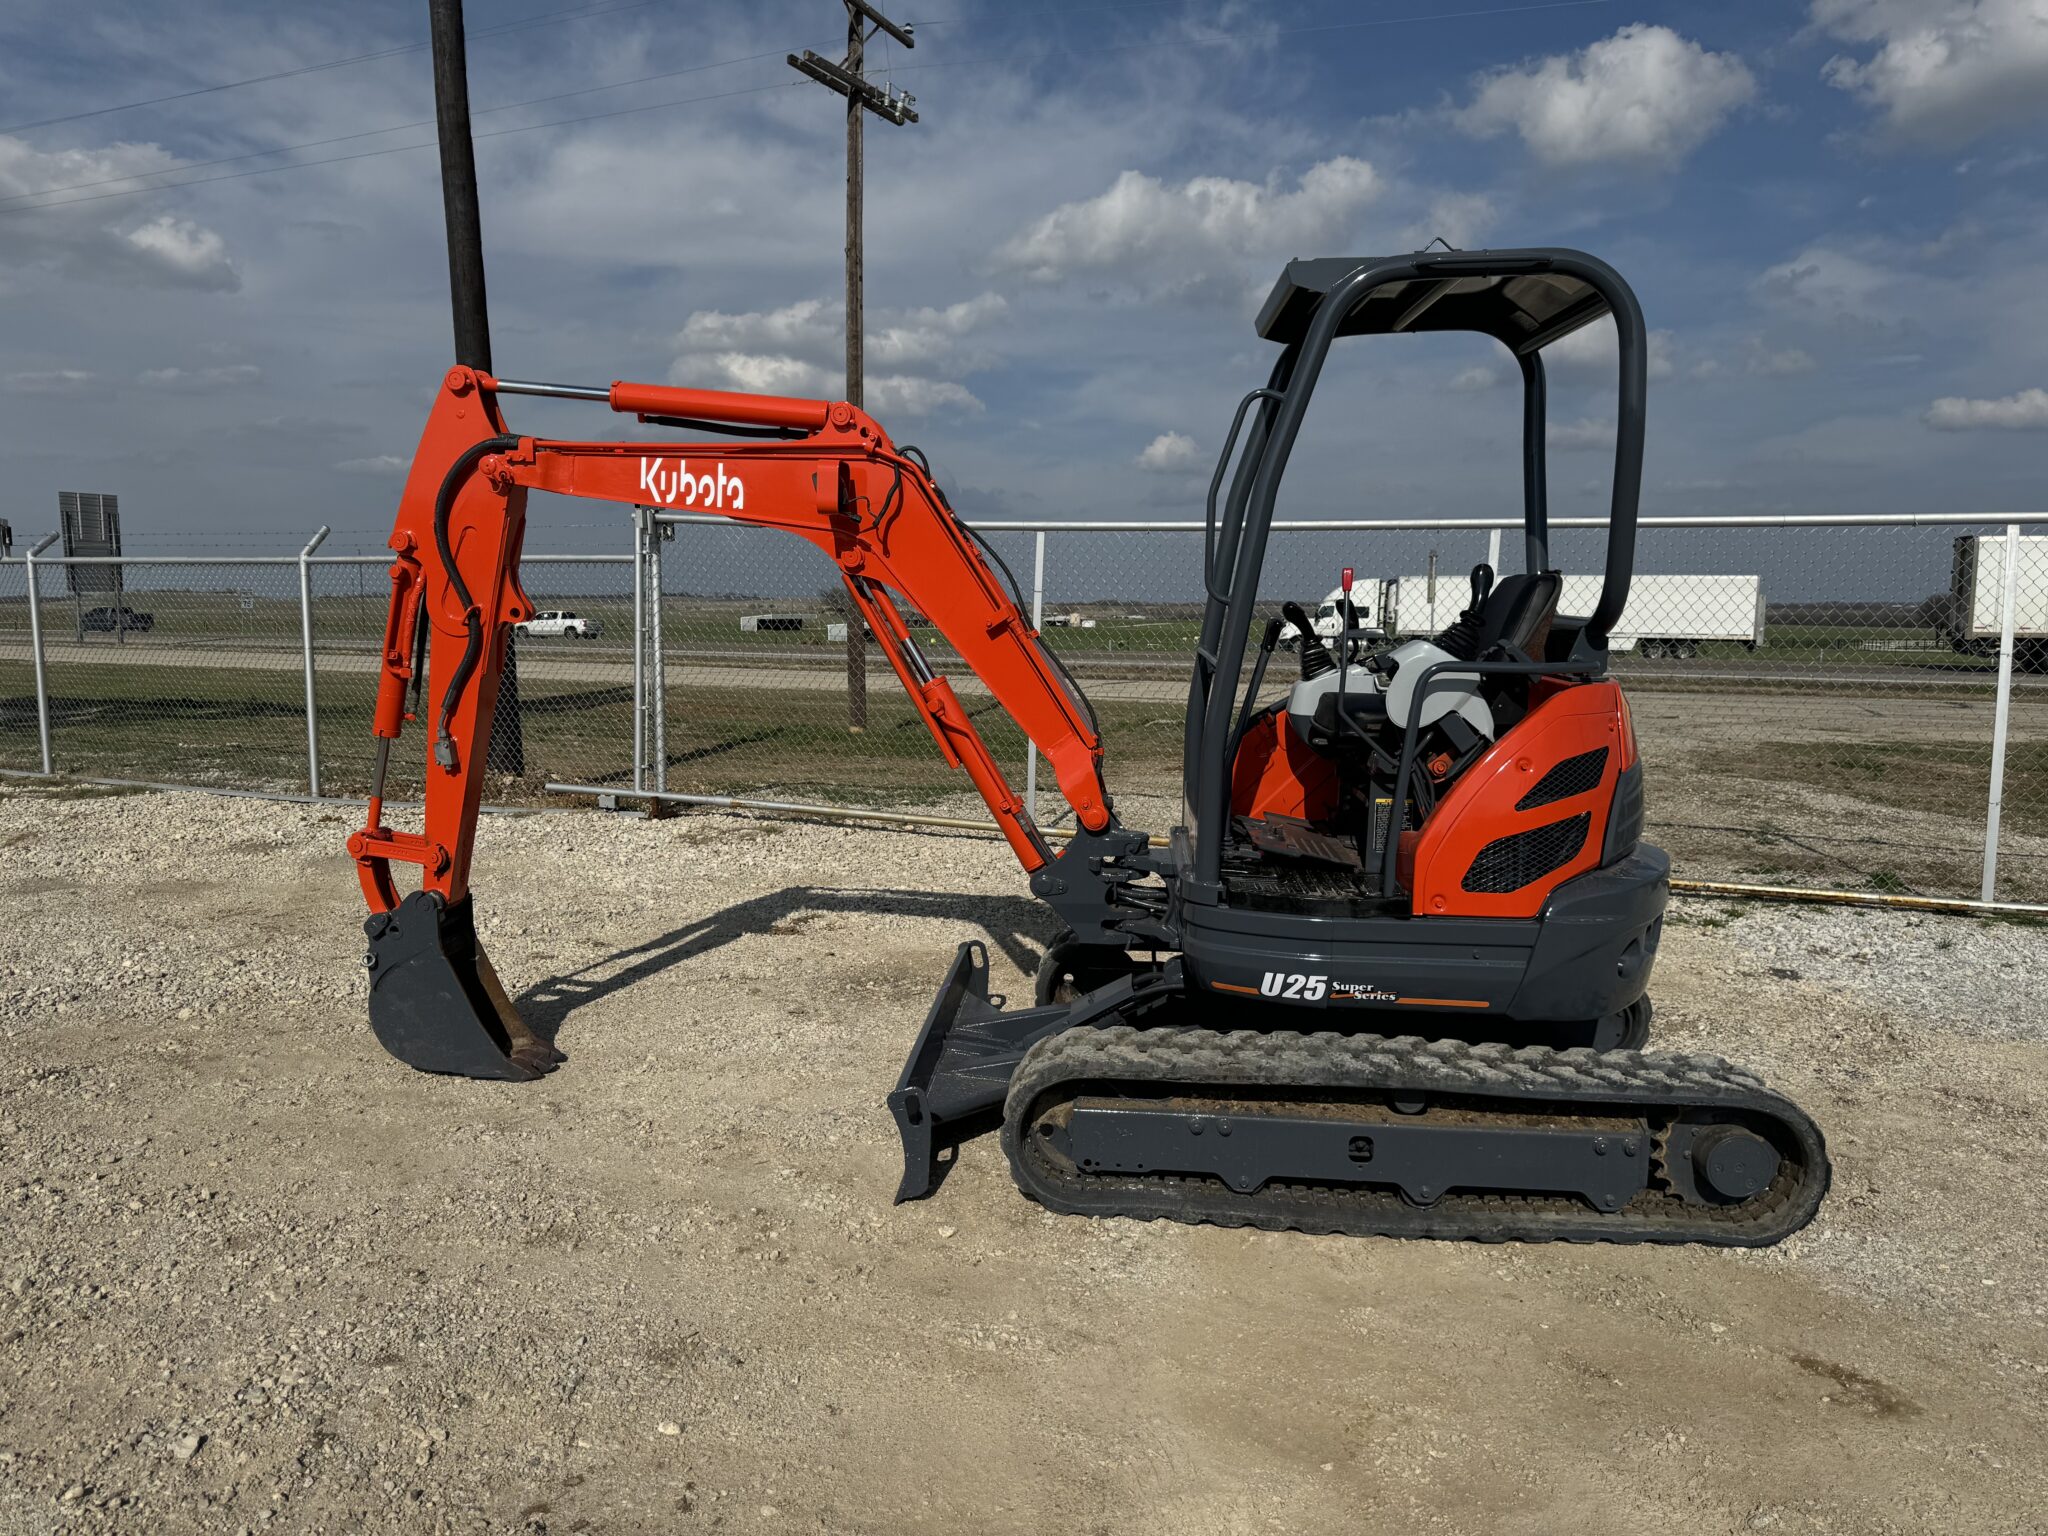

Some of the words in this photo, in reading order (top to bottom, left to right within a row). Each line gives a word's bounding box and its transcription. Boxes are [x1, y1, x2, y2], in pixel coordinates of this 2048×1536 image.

[640, 457, 744, 510] Kubota
[1260, 972, 1328, 1001] U25
[1331, 981, 1374, 993] Super
[1353, 991, 1397, 1001] Series
